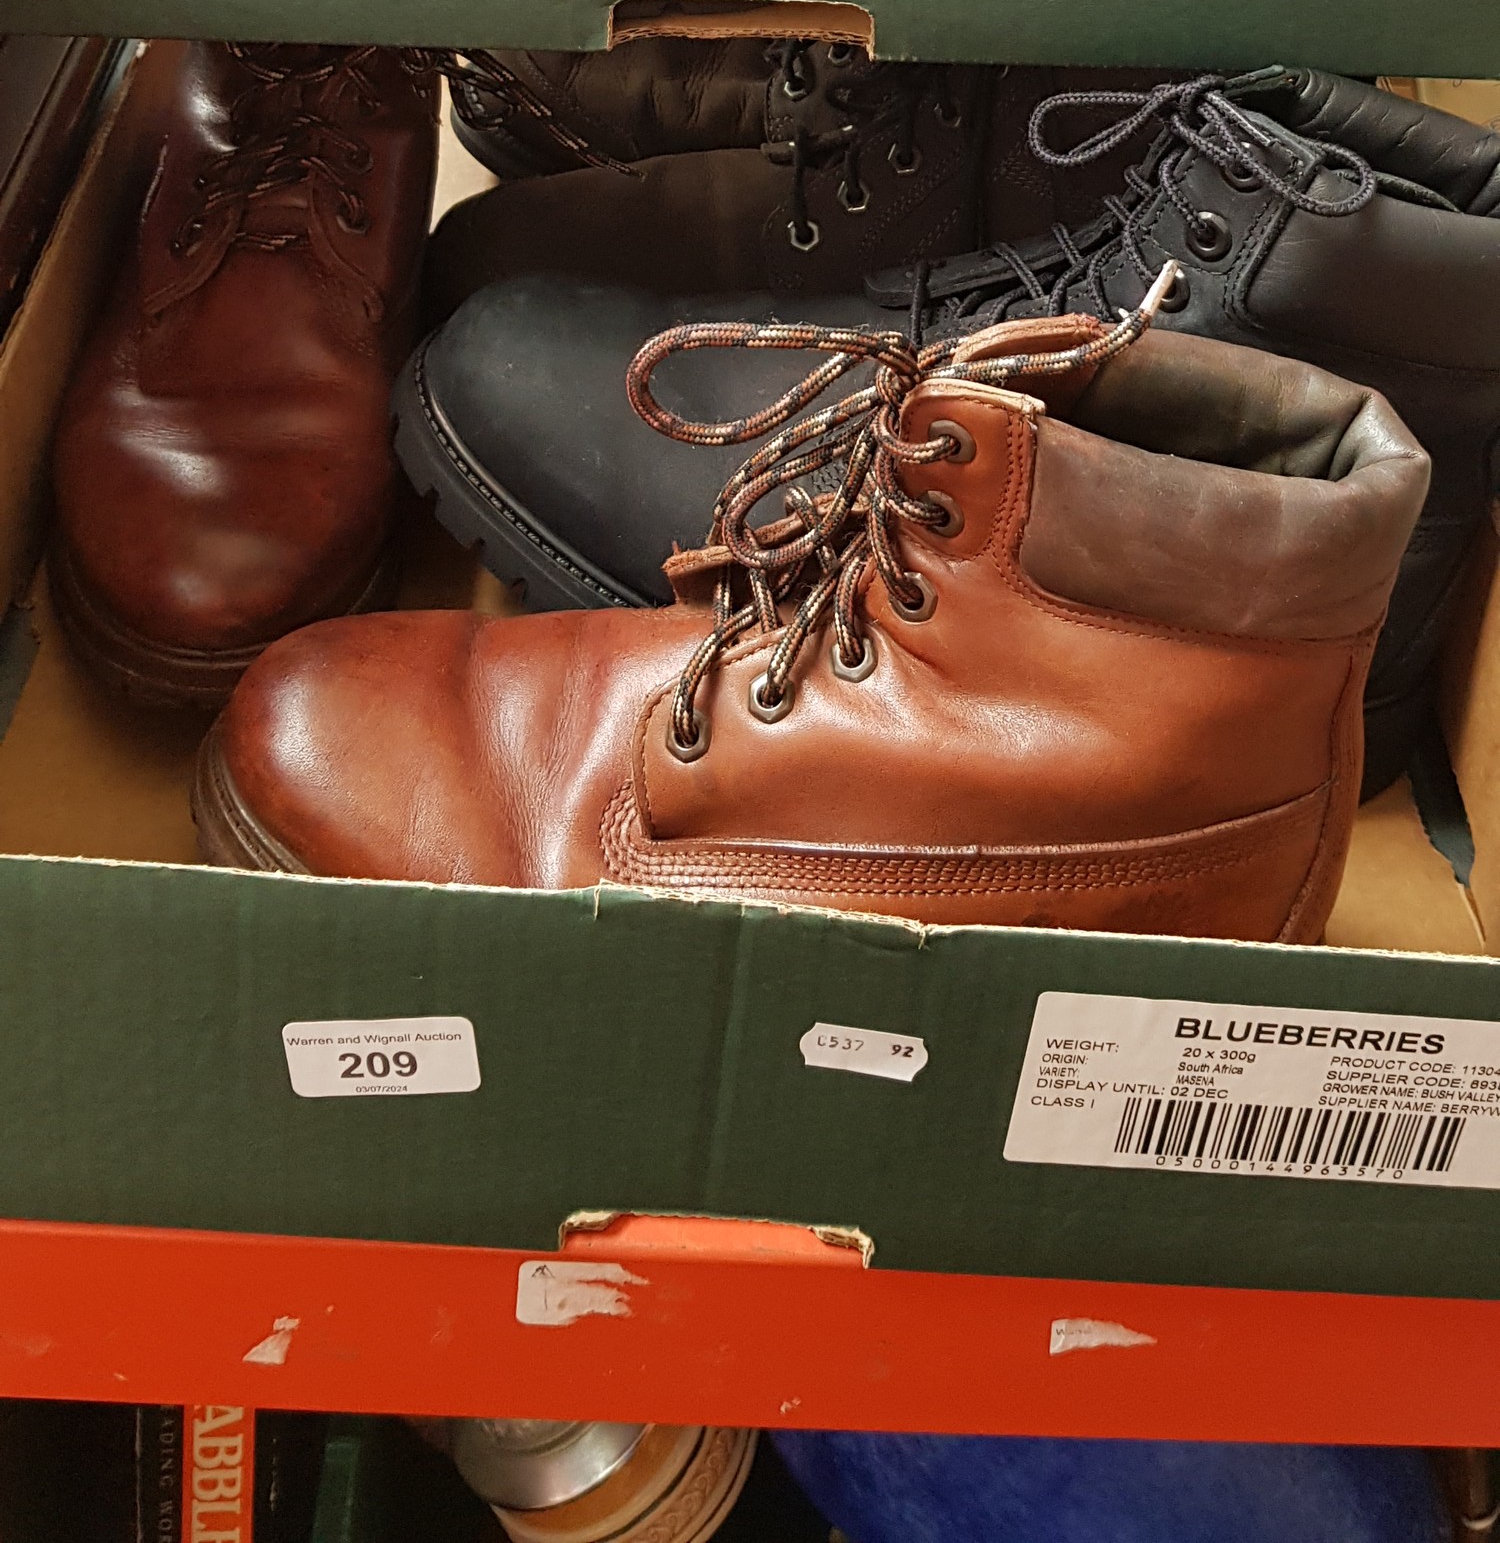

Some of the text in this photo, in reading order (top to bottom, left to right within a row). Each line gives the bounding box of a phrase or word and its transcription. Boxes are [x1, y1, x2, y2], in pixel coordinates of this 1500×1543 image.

[287, 1032, 462, 1047] Warren and Wignall Auction
[1174, 1017, 1445, 1055] BLUEBERRIES
[891, 1044, 914, 1058] 92
[1046, 1038, 1256, 1064] WEIGHT: 20 x 300g
[338, 1051, 418, 1079] 209
[1042, 1053, 1244, 1075] ORIGIN: South Africa
[1330, 1056, 1406, 1070] PRODUCT
[1409, 1062, 1456, 1074] CODE:
[1039, 1066, 1215, 1086] VARIETY: MASENA
[1326, 1071, 1408, 1085] SUPPLIER
[1413, 1076, 1465, 1088] CODE:
[355, 1085, 408, 1094] 03/07/2024
[1036, 1078, 1229, 1099] DISPLAY UNTIL: 02 DEC
[1322, 1083, 1377, 1095] GROWER
[1380, 1086, 1418, 1099] NAME:
[1421, 1089, 1454, 1100] BUSH
[1031, 1095, 1085, 1108] CLASS
[1318, 1095, 1388, 1109] SUPPLIER
[1392, 1100, 1436, 1113] NAME:
[158, 1404, 176, 1488] ADING
